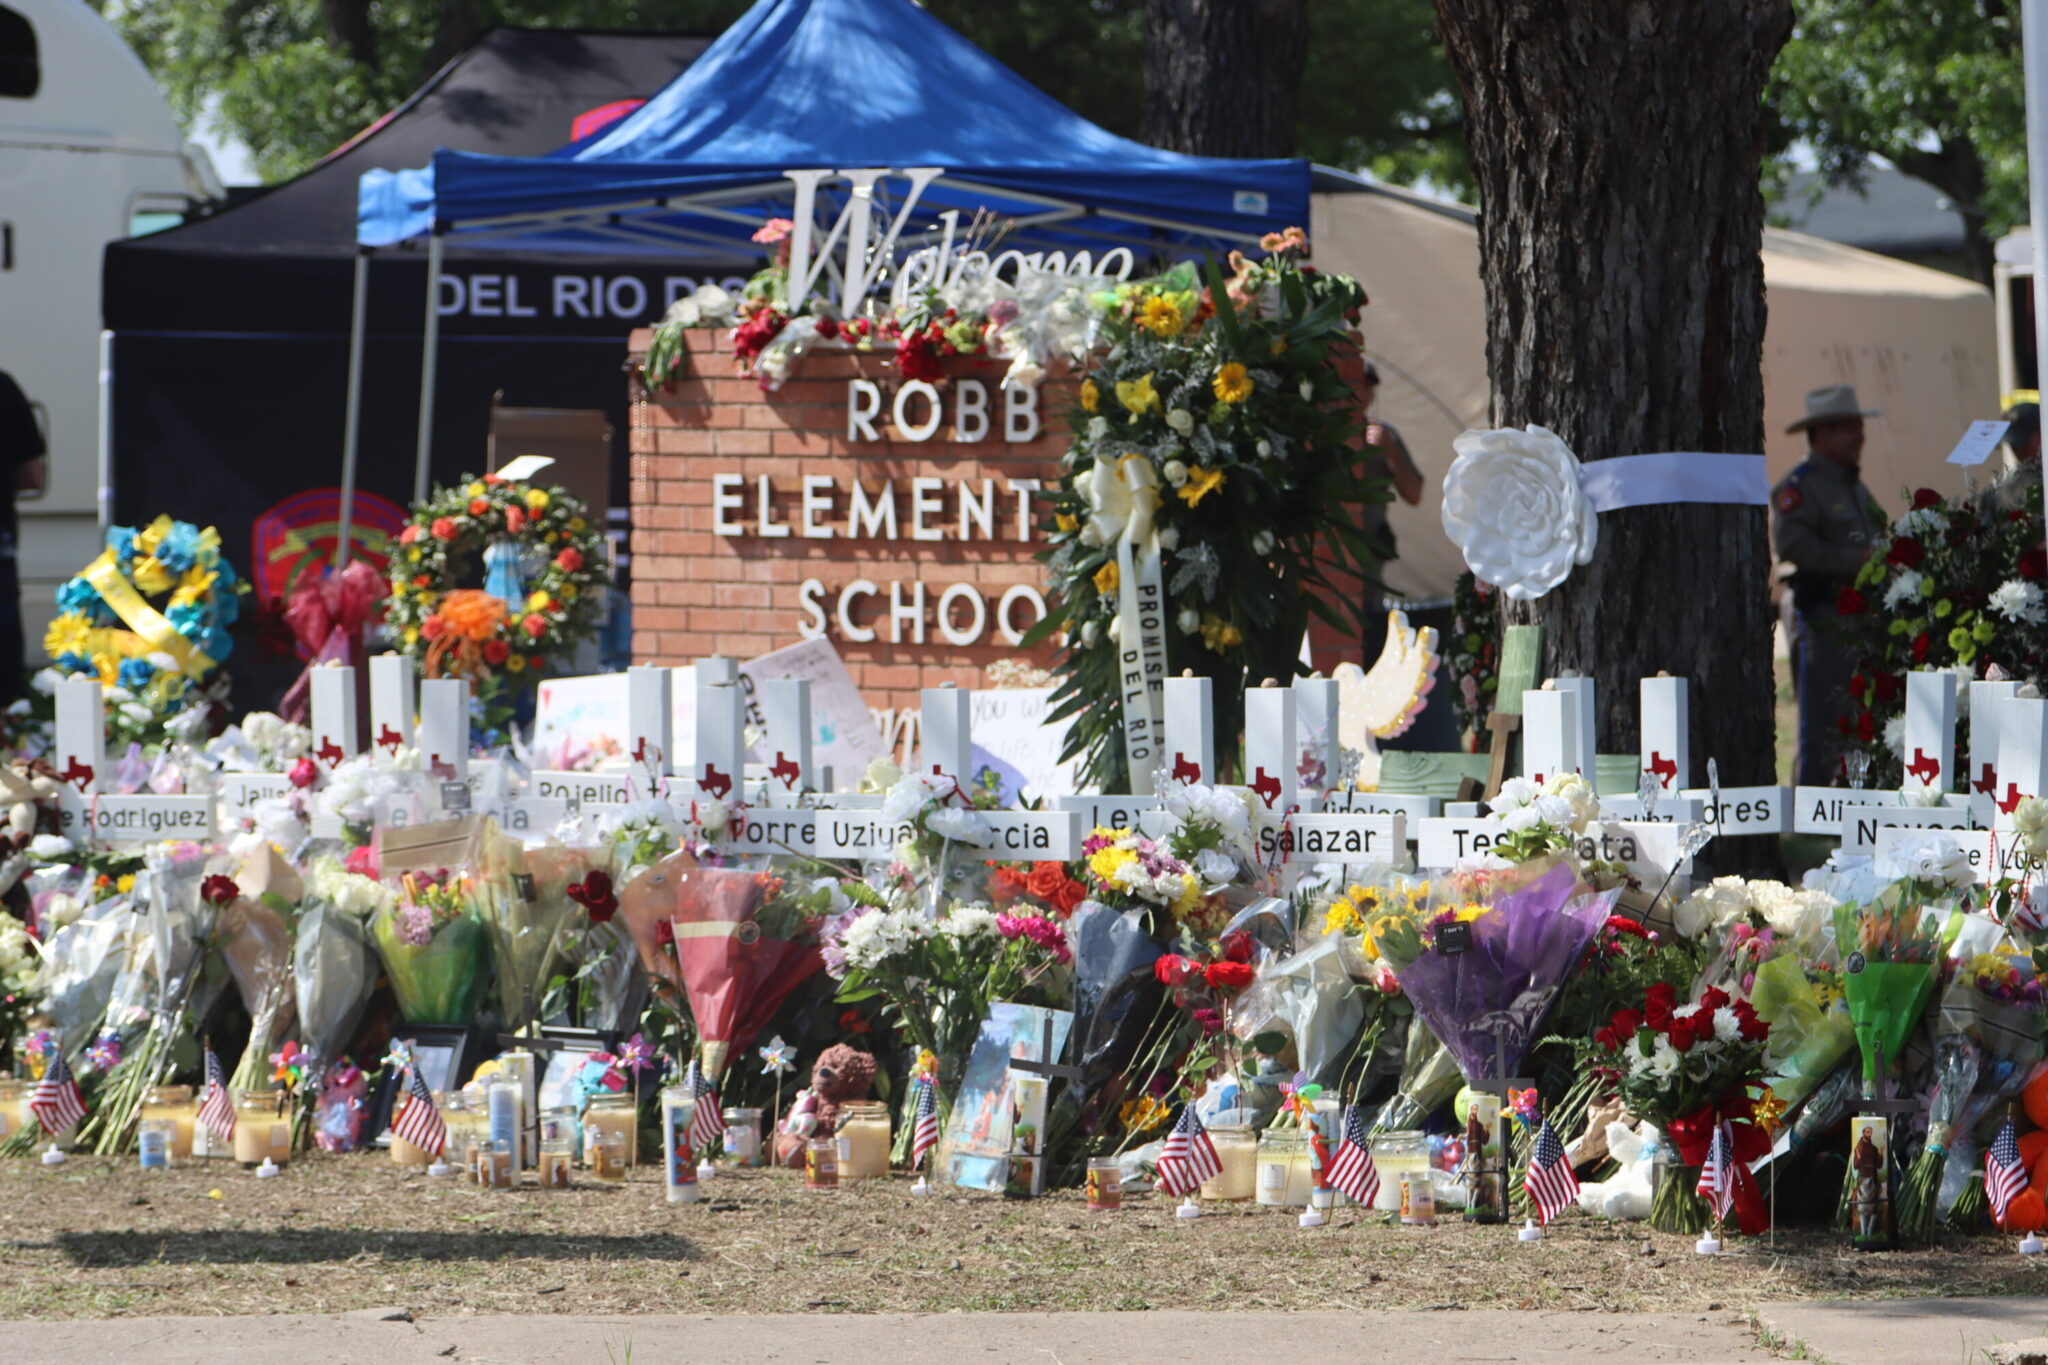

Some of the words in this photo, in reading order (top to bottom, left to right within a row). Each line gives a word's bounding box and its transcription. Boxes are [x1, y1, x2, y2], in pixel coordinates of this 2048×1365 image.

[437, 274, 538, 317] DEL
[553, 275, 648, 318] RIO
[848, 379, 1040, 443] ROBB
[713, 473, 1042, 542] ELEMENT
[797, 578, 1047, 646] SCHOO
[1123, 650, 1143, 704] DEL
[1129, 718, 1149, 760] RIO
[82, 807, 209, 832] Rodriguez
[1260, 826, 1377, 853] Salazar
